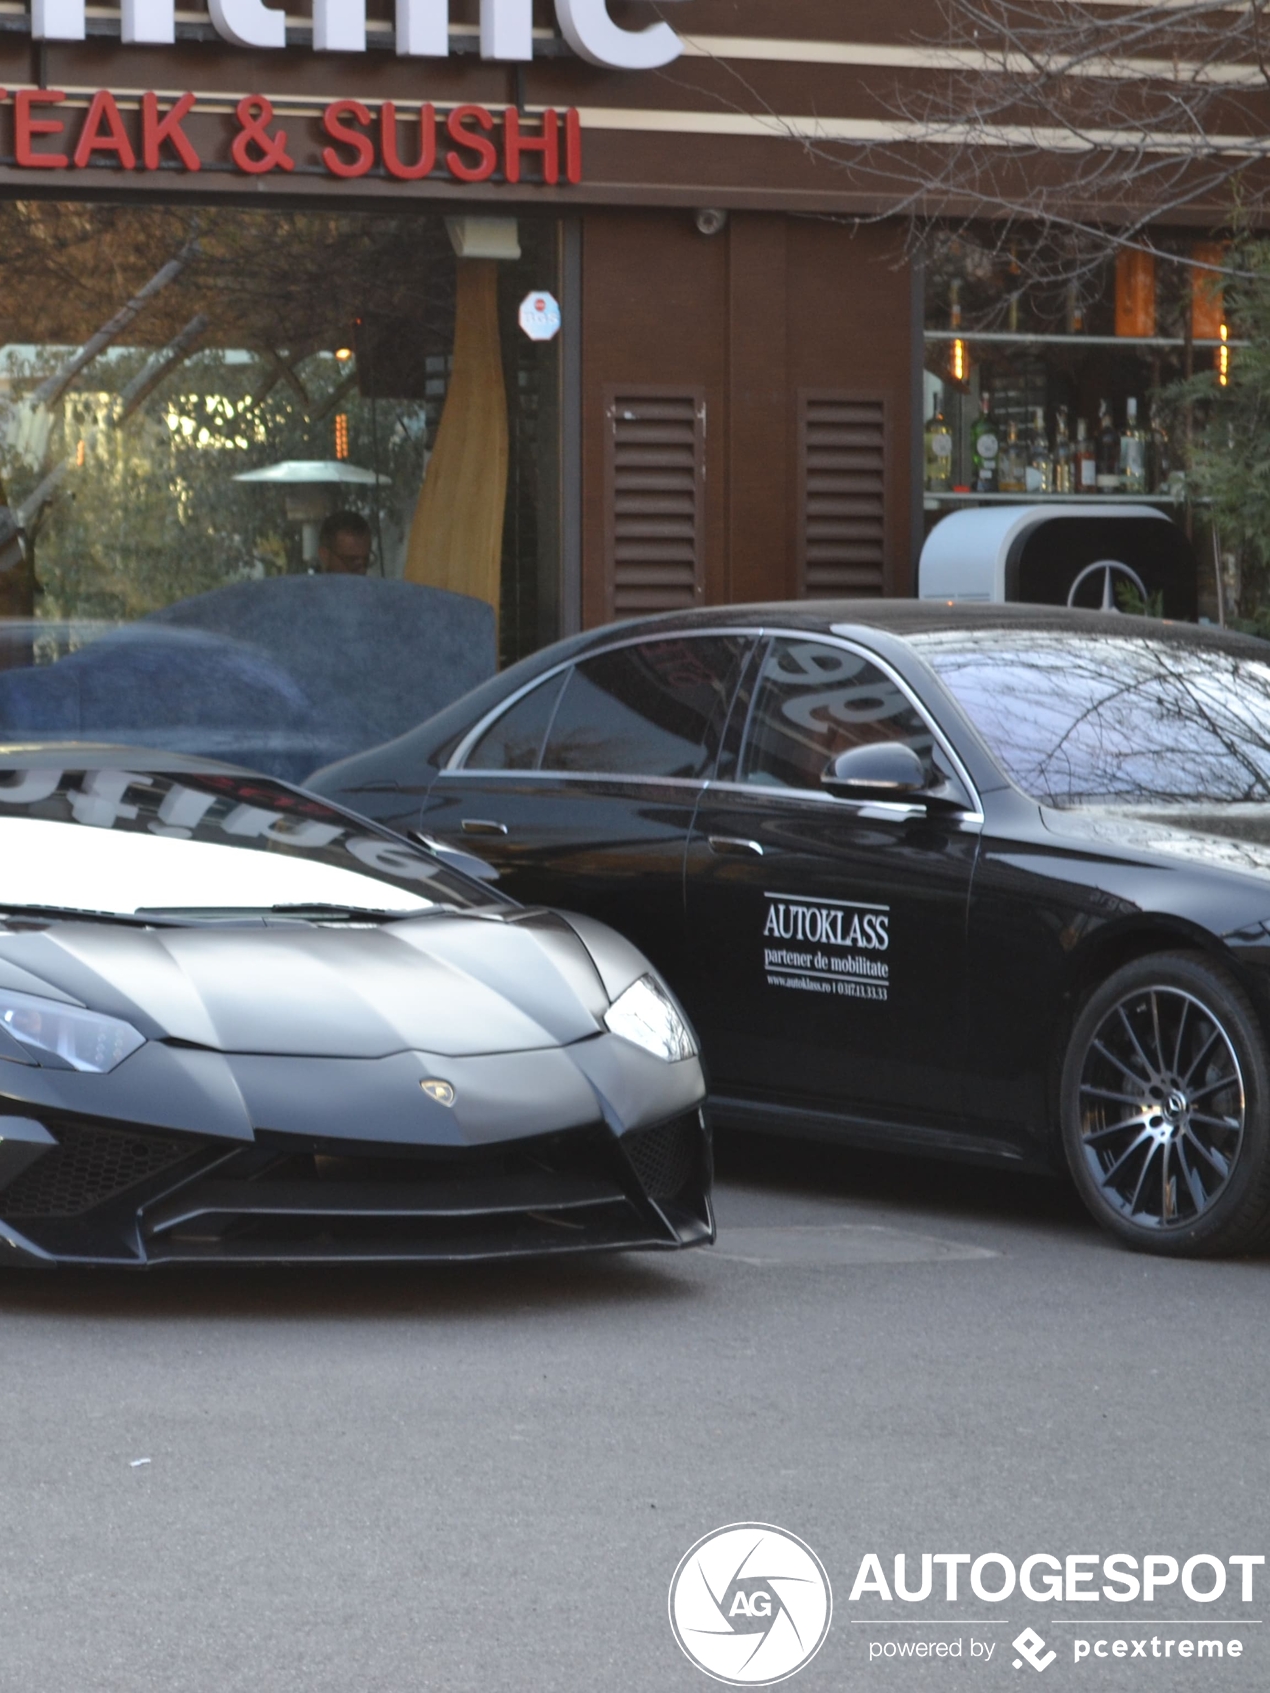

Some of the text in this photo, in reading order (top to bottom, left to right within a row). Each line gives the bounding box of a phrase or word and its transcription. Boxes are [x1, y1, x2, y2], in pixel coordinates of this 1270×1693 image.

[232, 93, 295, 174] &
[322, 99, 581, 185] SUSHI
[763, 903, 889, 951] AUTOKLASS
[764, 948, 889, 978] partener de mobilitate
[767, 975, 831, 993] www.autoklass.ro
